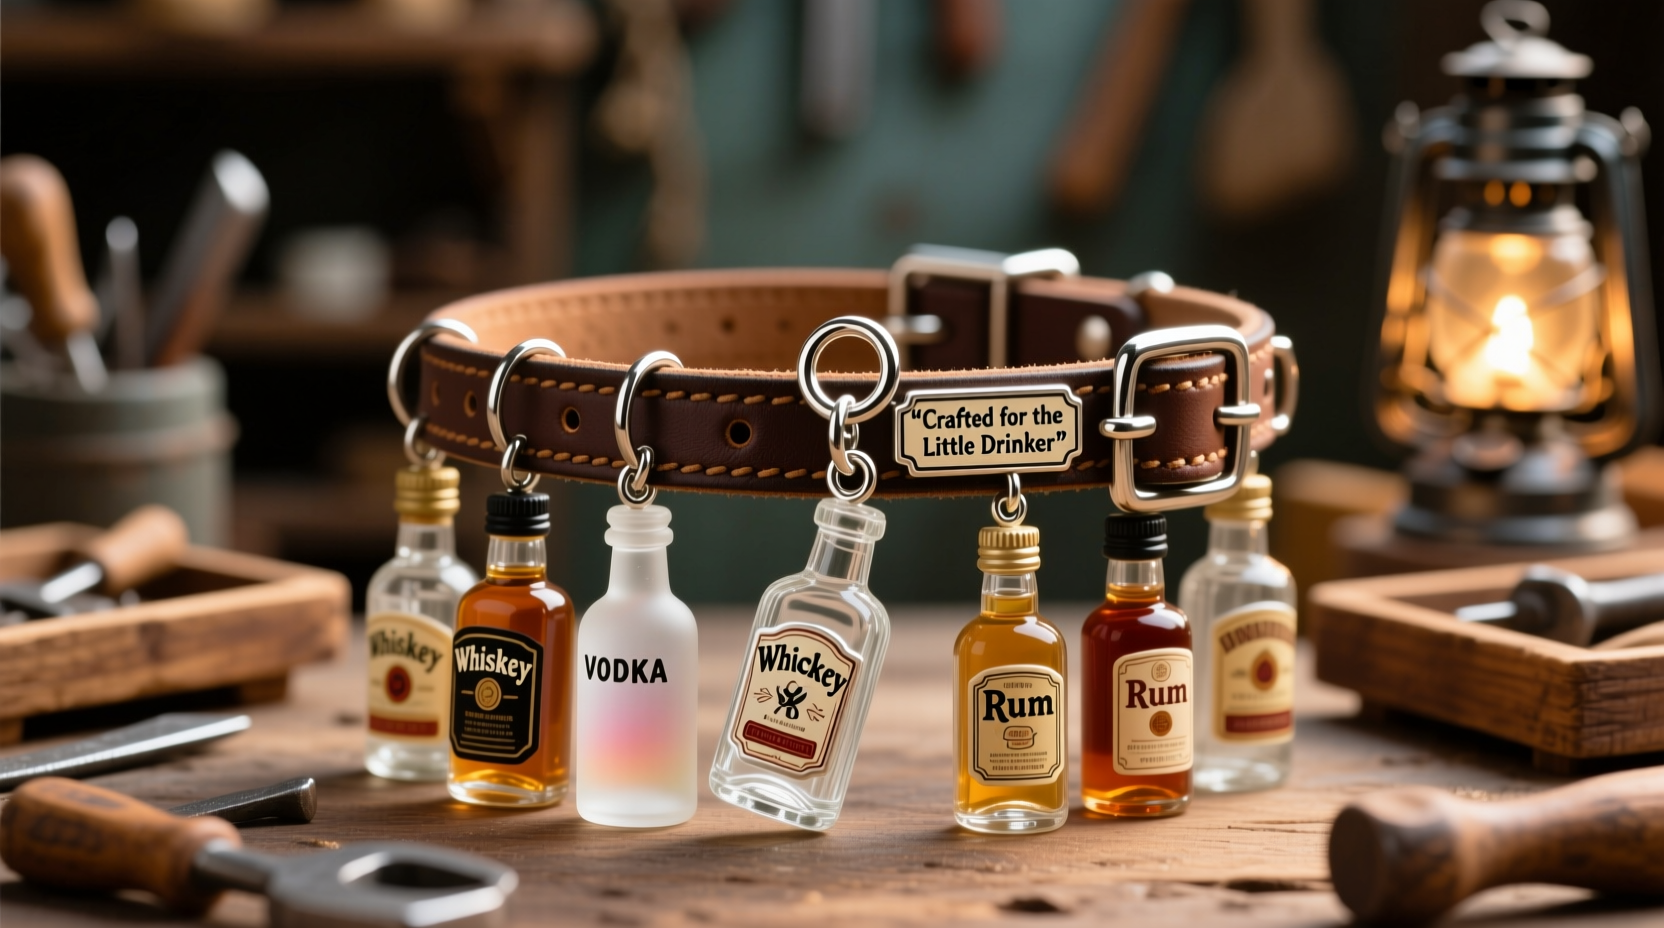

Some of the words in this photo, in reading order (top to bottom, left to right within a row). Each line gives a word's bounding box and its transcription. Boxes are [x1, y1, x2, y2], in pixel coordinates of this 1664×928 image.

[911, 406, 994, 430] “Crafted
[1000, 406, 1028, 427] for
[1032, 404, 1063, 425] the
[923, 435, 975, 457] Little
[981, 430, 1067, 455] Drinker”
[368, 629, 444, 674] Whiskey
[454, 644, 533, 686] Whiskey
[584, 653, 668, 684] VODKA
[758, 643, 848, 697] Whickey
[982, 689, 1054, 723] Rum
[1125, 679, 1188, 709] Rum
